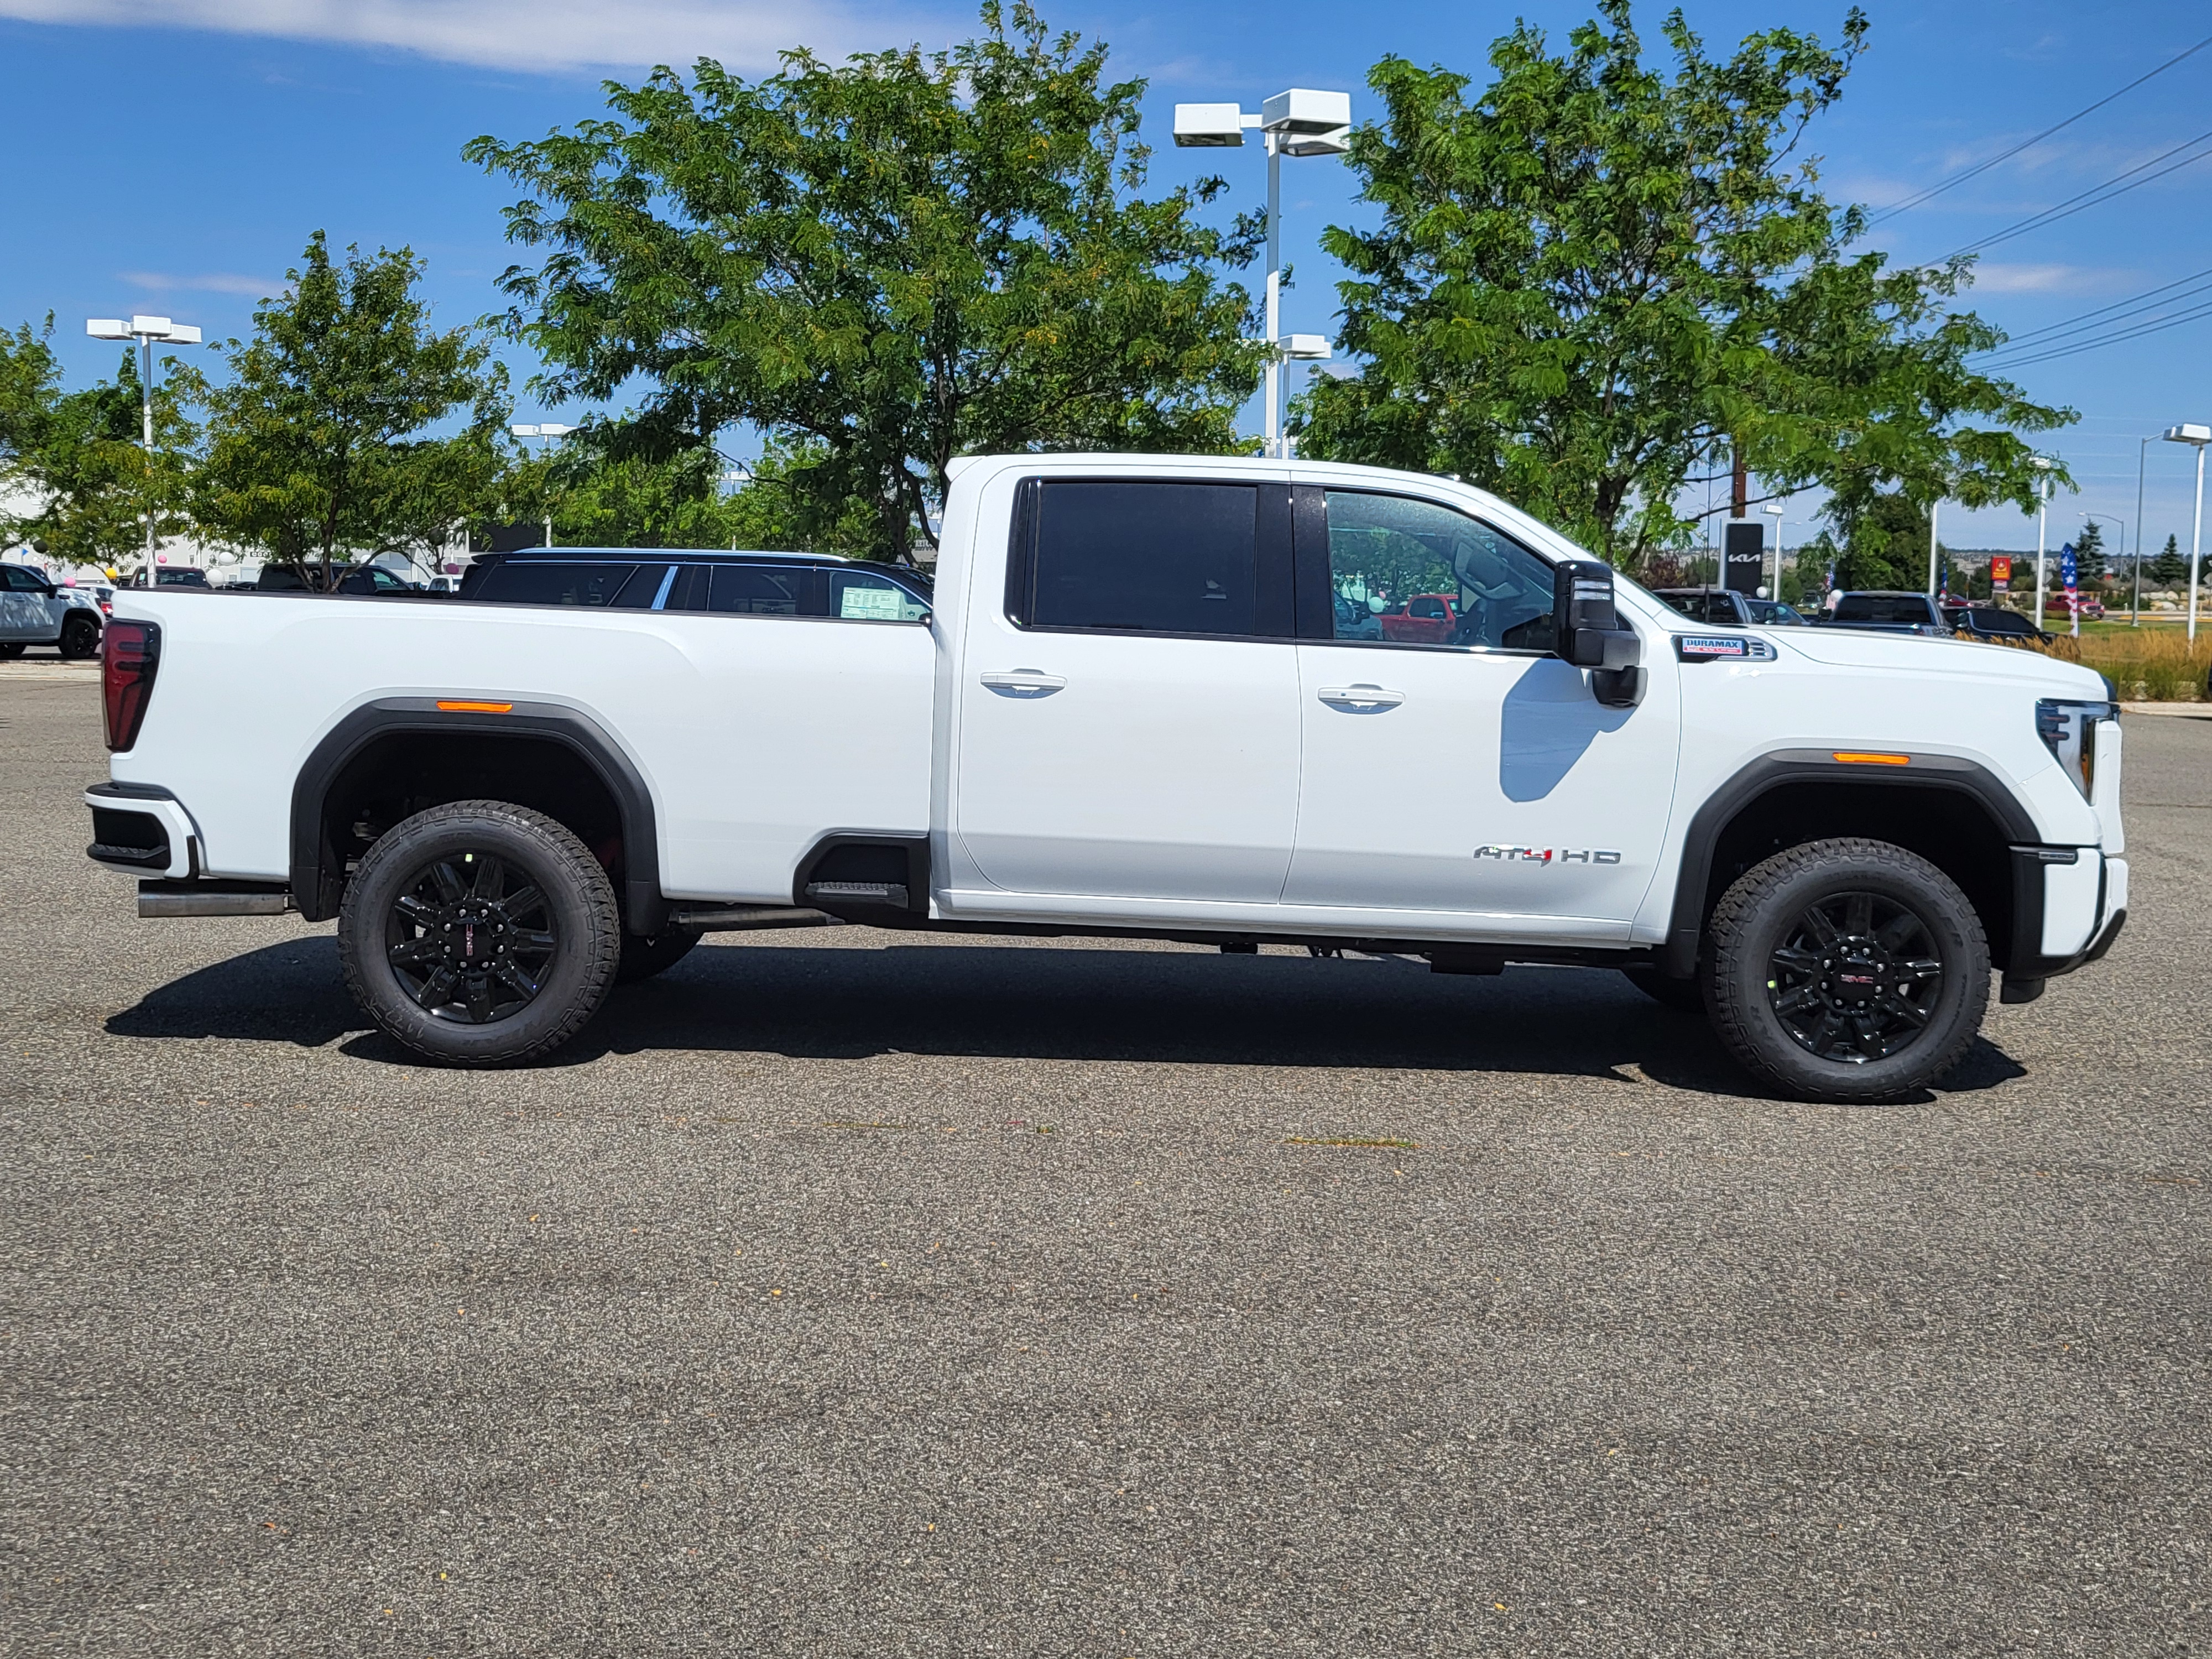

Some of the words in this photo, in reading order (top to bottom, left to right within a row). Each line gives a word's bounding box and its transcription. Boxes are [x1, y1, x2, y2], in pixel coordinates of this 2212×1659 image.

[1728, 554, 1761, 562] KIA
[1687, 639, 1738, 648] DURAMAX
[1473, 844, 1552, 868] AT4
[1561, 847, 1621, 864] HD
